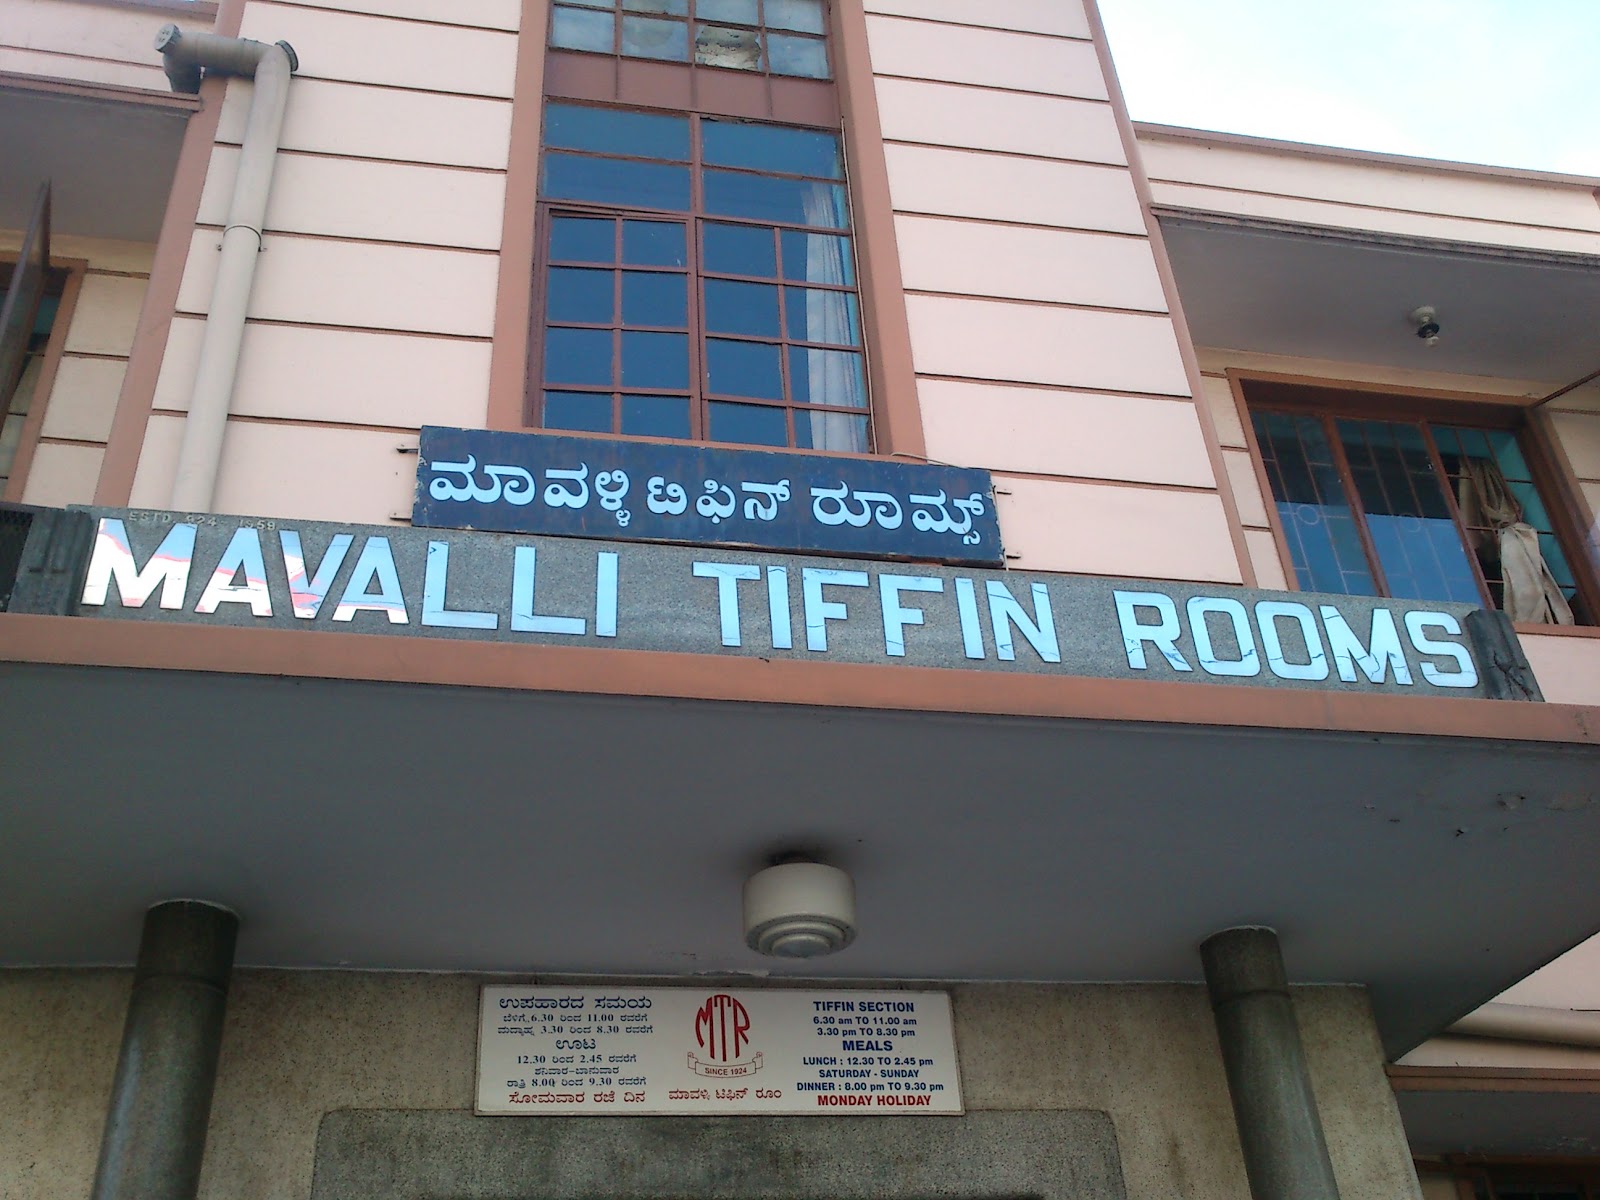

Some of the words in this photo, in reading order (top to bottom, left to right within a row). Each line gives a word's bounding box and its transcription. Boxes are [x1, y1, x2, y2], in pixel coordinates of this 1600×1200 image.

[428, 453, 631, 529] ಮಾವಳ್ಳಿ
[645, 475, 791, 526] ಟಿಫಿನ್
[809, 480, 987, 546] ರೂಮ್ಸ್
[81, 517, 619, 638] MAVALLI
[691, 561, 1062, 664] TIFFIN
[1112, 589, 1479, 689] ROOMS
[499, 996, 585, 1010] ಉಪಹಾರದ
[594, 996, 653, 1010] ಸಮಯ
[813, 1001, 855, 1012] TIFFIN
[858, 1001, 915, 1013] SECTION
[588, 1013, 614, 1023] 11.00
[813, 1016, 835, 1025] 6.30
[838, 1017, 853, 1025] am
[855, 1016, 870, 1025] TO
[873, 1016, 901, 1026] 11.00
[902, 1017, 918, 1026] am
[540, 1025, 564, 1035] 3.30
[596, 1025, 620, 1035] 8.30
[695, 994, 751, 1062] MTR
[817, 1027, 839, 1036] 3.30
[842, 1029, 857, 1038] pm
[859, 1027, 874, 1036] TO
[876, 1027, 899, 1037] 8.30
[901, 1029, 916, 1038] pm
[555, 1038, 597, 1050] ಊಟ
[842, 1040, 894, 1052] MEALS
[516, 1055, 547, 1065] 12.30
[579, 1054, 603, 1064] 2.45
[803, 1056, 838, 1066] LUNCH
[847, 1056, 875, 1066] 12.30
[877, 1056, 892, 1066] TO
[894, 1056, 917, 1066] 2.45
[919, 1058, 934, 1067] pm
[704, 1067, 728, 1076] SINCE
[730, 1067, 747, 1075] 1924
[818, 1069, 872, 1078] SATURDAY
[880, 1069, 920, 1078] SUNDAY
[588, 1077, 613, 1087] 9.30
[796, 1082, 836, 1091] DINNER
[844, 1082, 868, 1091] 8.00
[870, 1084, 885, 1093] pm
[887, 1082, 902, 1091] TO
[904, 1082, 927, 1091] 9.30
[929, 1083, 944, 1092] pm
[508, 1091, 586, 1104] ಸೋಮವಾರ
[593, 1091, 616, 1104] ರಜೆ
[623, 1091, 646, 1103] ದಿನ
[817, 1095, 873, 1106] MONDAY
[876, 1095, 932, 1106] HOLIDAY
